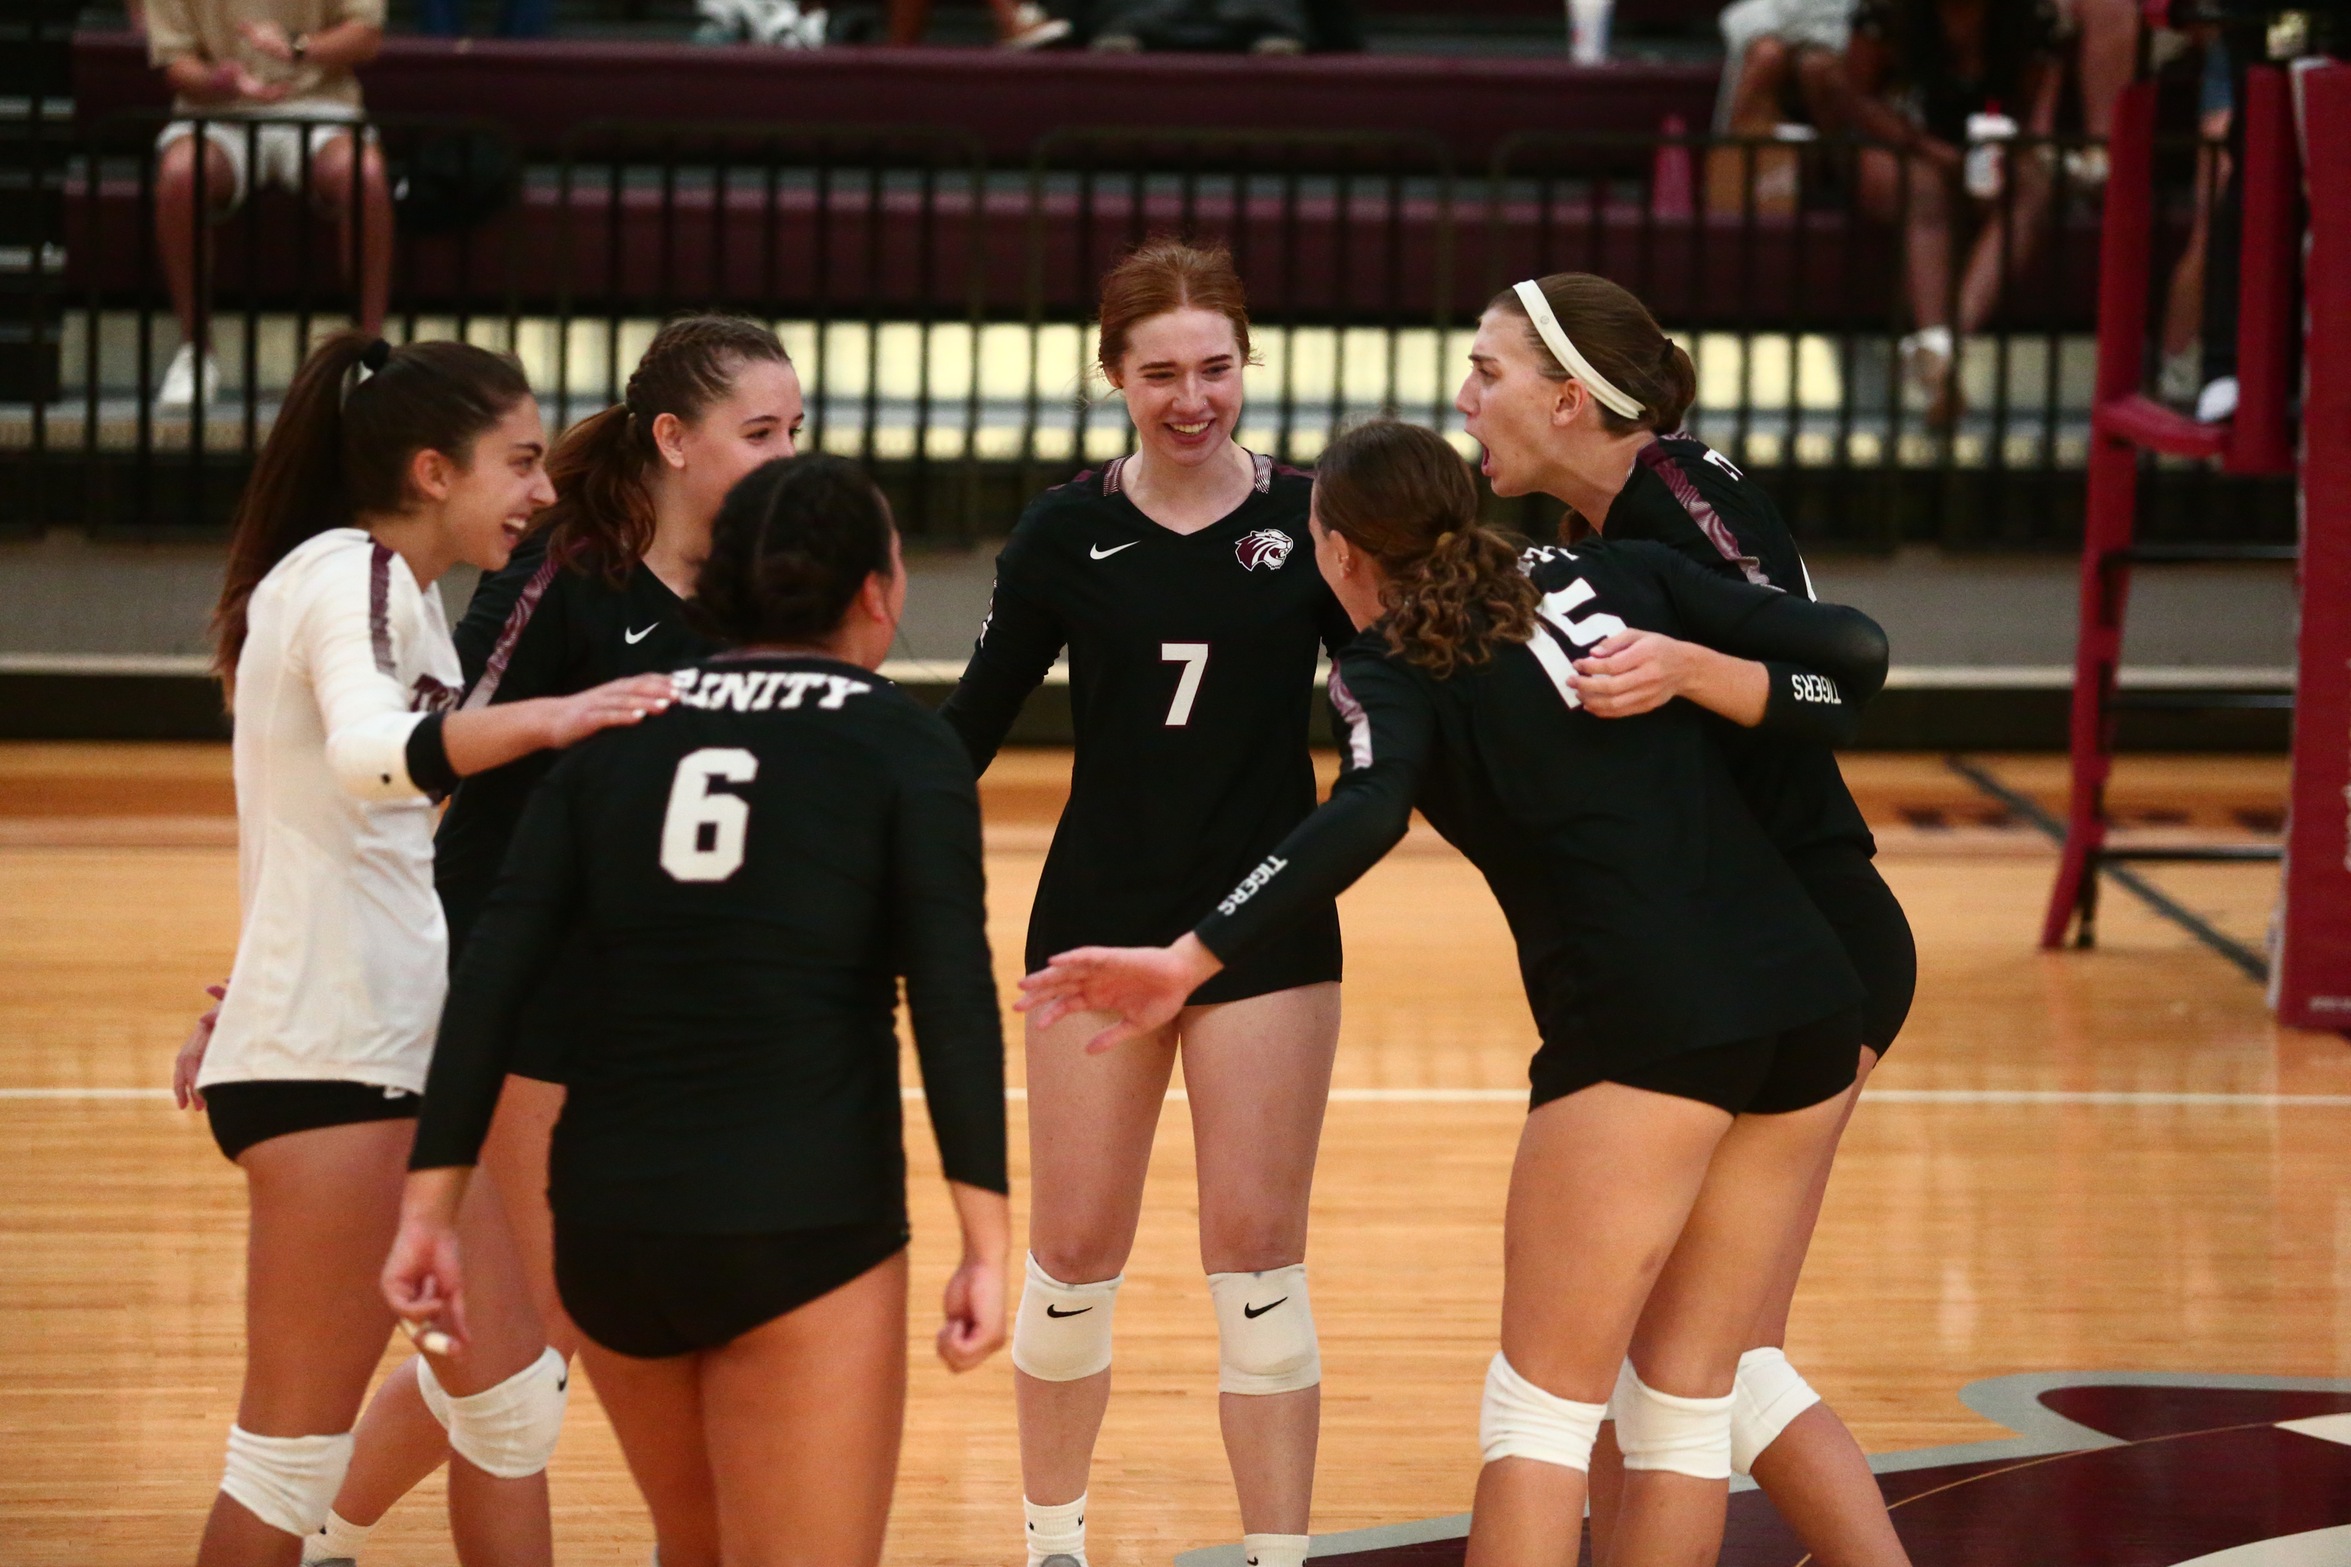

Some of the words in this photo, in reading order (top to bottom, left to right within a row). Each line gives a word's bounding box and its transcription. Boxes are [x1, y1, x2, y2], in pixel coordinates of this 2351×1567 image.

[672, 667, 873, 712] RINITY
[1160, 642, 1209, 726] 7
[1791, 674, 1842, 704] TIGERS
[660, 748, 759, 882] 6
[1217, 855, 1288, 915] TIGERS
